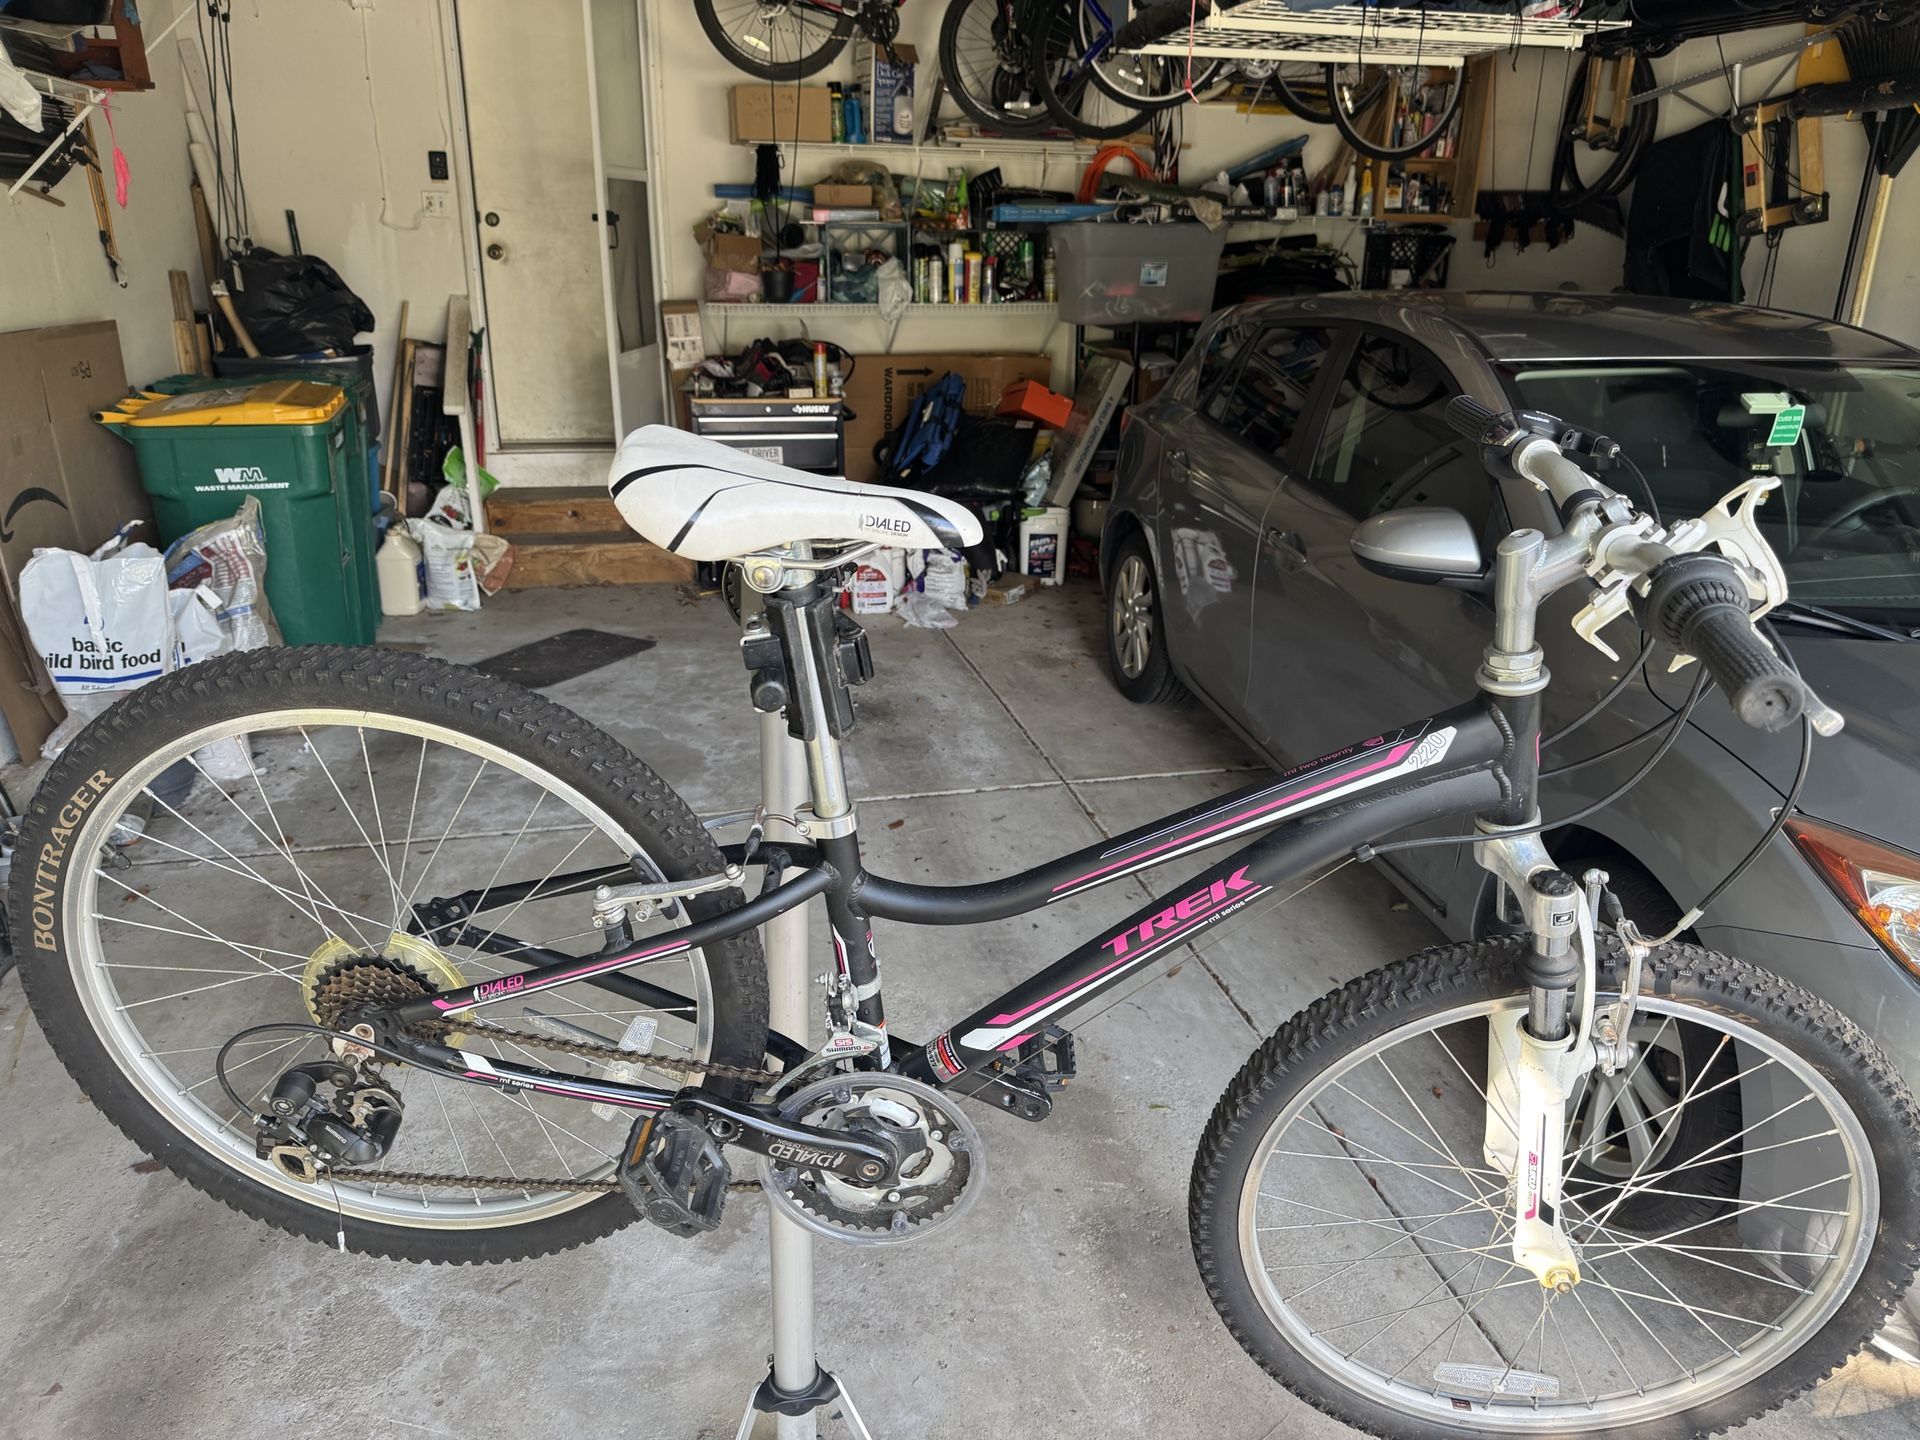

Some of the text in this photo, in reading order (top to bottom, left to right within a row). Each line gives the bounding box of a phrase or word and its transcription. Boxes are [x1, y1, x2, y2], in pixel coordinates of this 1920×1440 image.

[802, 405, 830, 413] HUSKY
[227, 482, 290, 491] MANAGEMENT
[865, 515, 911, 532] DIALED
[72, 637, 123, 653] baic
[80, 655, 114, 670] bird
[121, 649, 161, 668] food
[1300, 760, 1320, 772] two
[1320, 746, 1354, 764] twenty
[1408, 731, 1448, 770] 220
[32, 768, 115, 952] BONTRAGER
[1101, 864, 1254, 957] TREK
[1208, 900, 1246, 924] mt series
[480, 974, 524, 996] DIALED
[512, 1080, 534, 1089] series
[325, 1124, 346, 1144] SHIMANO
[768, 1143, 832, 1168] DIALED
